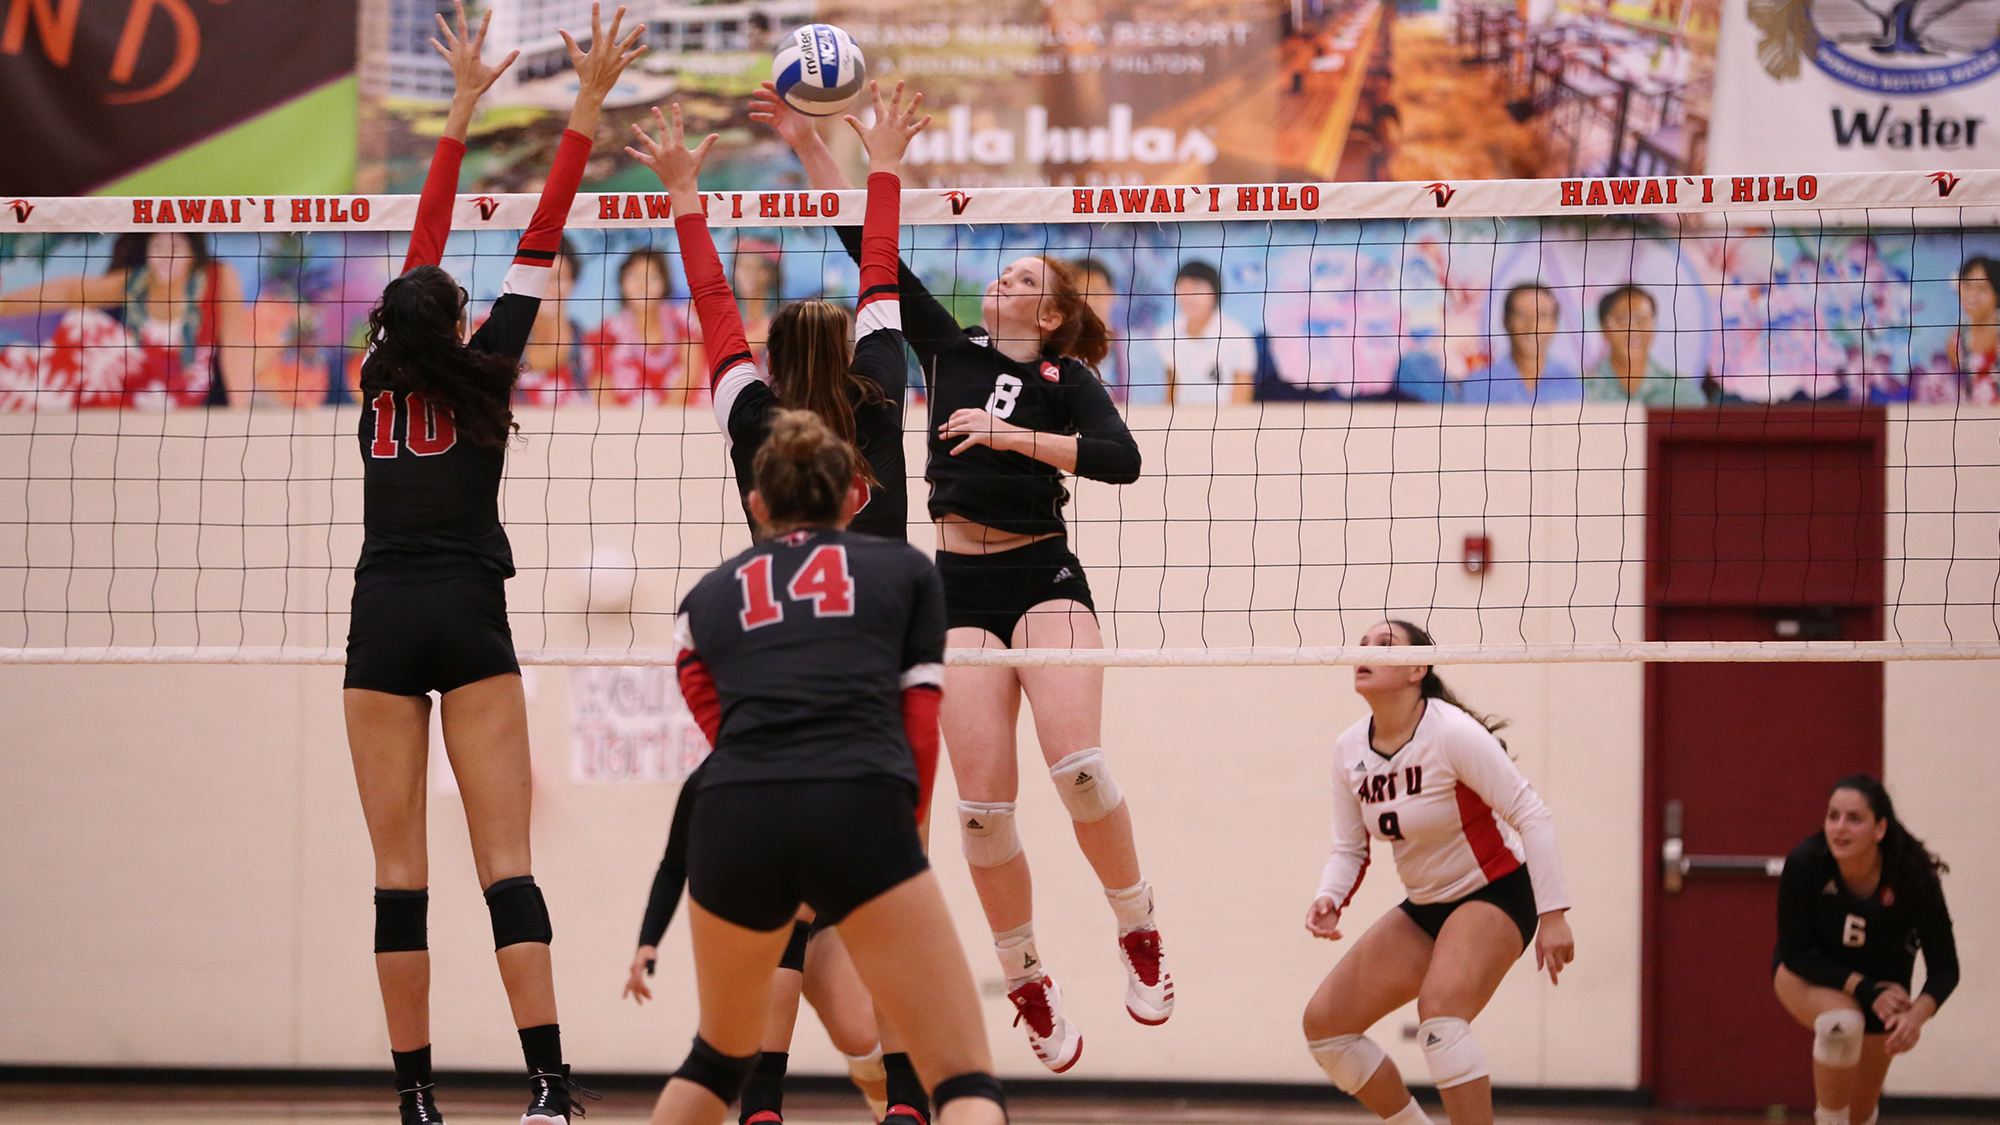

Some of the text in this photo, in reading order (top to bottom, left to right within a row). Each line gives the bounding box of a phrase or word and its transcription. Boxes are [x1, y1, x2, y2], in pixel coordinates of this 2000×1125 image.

[816, 29, 837, 66] NCAA
[1025, 102, 1218, 165] hulas
[1830, 103, 1986, 148] Water
[759, 192, 840, 218] HILO
[1236, 186, 1319, 211] HILO
[1731, 175, 1818, 202] HILO
[290, 198, 371, 222] HILO
[985, 373, 1024, 420] 8
[370, 389, 457, 459] 10
[735, 544, 856, 632] 14
[1405, 765, 1423, 796] U
[1378, 811, 1406, 840] 9
[1842, 913, 1866, 947] 6
